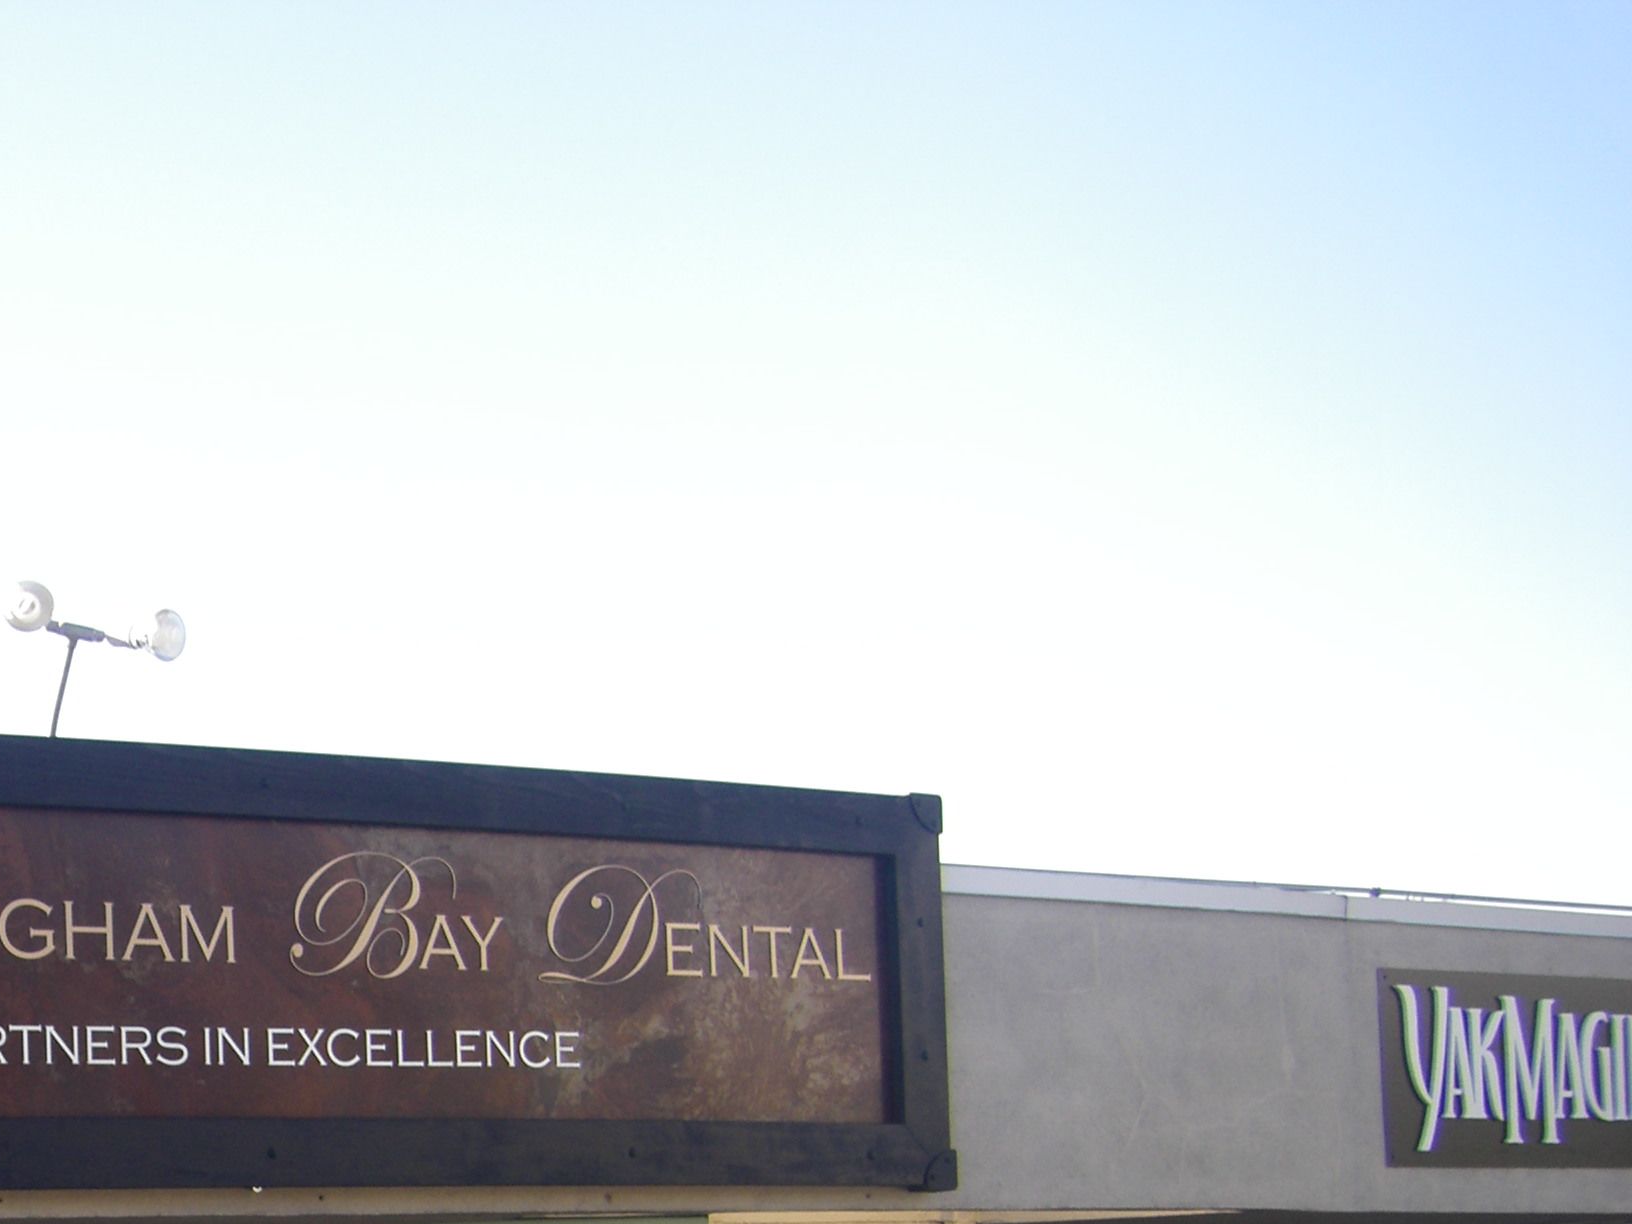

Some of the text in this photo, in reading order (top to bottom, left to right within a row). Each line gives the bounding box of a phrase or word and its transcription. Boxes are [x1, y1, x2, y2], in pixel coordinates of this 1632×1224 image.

[290, 850, 504, 980] BAY
[537, 864, 872, 986] DENTAL
[204, 1027, 251, 1066] IN
[267, 1027, 581, 1068] EXCELLENCE
